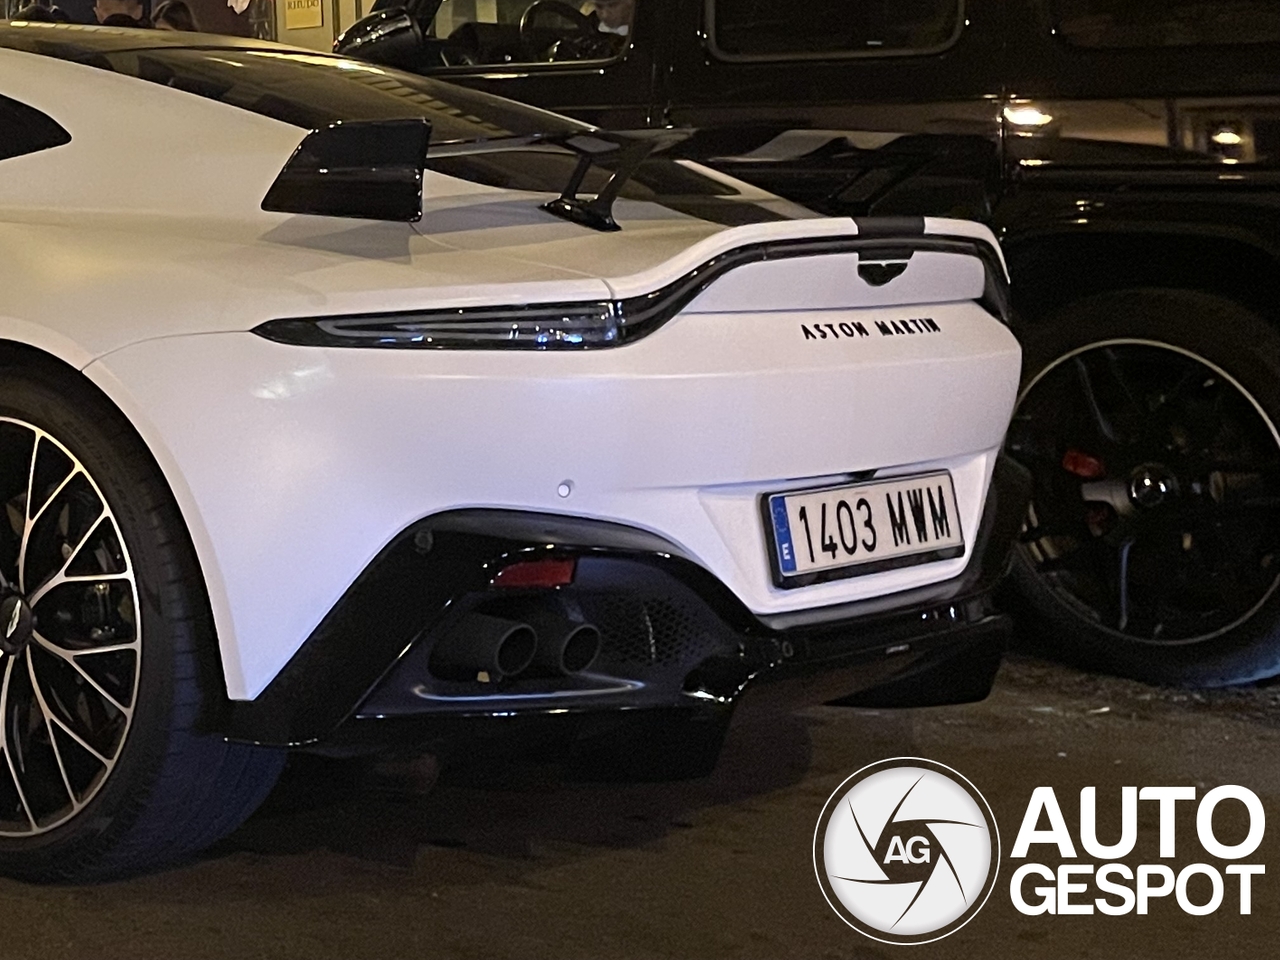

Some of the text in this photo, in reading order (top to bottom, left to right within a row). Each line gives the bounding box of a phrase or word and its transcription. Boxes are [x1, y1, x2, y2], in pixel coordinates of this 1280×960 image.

[801, 318, 941, 340] ASTON MARTIN
[781, 485, 951, 564] E 1403 MWM
